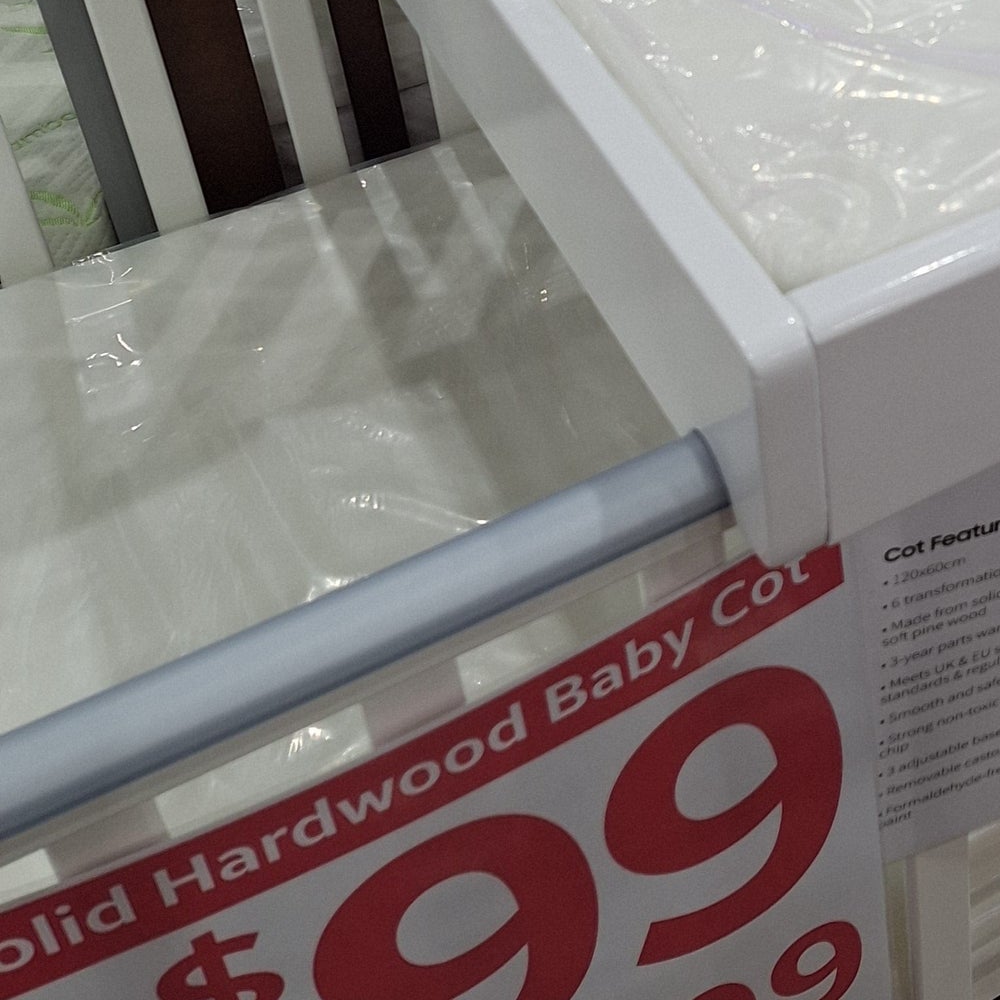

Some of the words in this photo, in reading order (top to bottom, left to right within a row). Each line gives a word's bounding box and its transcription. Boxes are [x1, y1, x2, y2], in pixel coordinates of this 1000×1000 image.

[884, 541, 926, 563] Cot
[893, 557, 967, 585] 120x60cm
[890, 612, 932, 631] Made
[935, 602, 968, 619] from
[891, 599, 902, 610] 6
[881, 630, 909, 648] soft
[911, 620, 945, 641] pine
[946, 606, 988, 629] wood
[890, 646, 940, 668] 3-year
[937, 632, 974, 654] parts
[889, 670, 931, 689] Meets
[934, 661, 955, 675] UK
[957, 656, 969, 669] &
[971, 647, 991, 664] EU
[880, 674, 950, 705] standards
[952, 668, 964, 682] &
[888, 696, 945, 722] Smooth
[947, 685, 975, 703] and
[153, 702, 529, 909] Hardwood
[545, 617, 695, 725] Baby
[710, 553, 811, 629] Cot
[887, 720, 934, 742] Strong
[936, 699, 1000, 728] non-toxic
[878, 740, 910, 761] chip
[898, 740, 970, 775] adjustable
[886, 764, 962, 797] Removable
